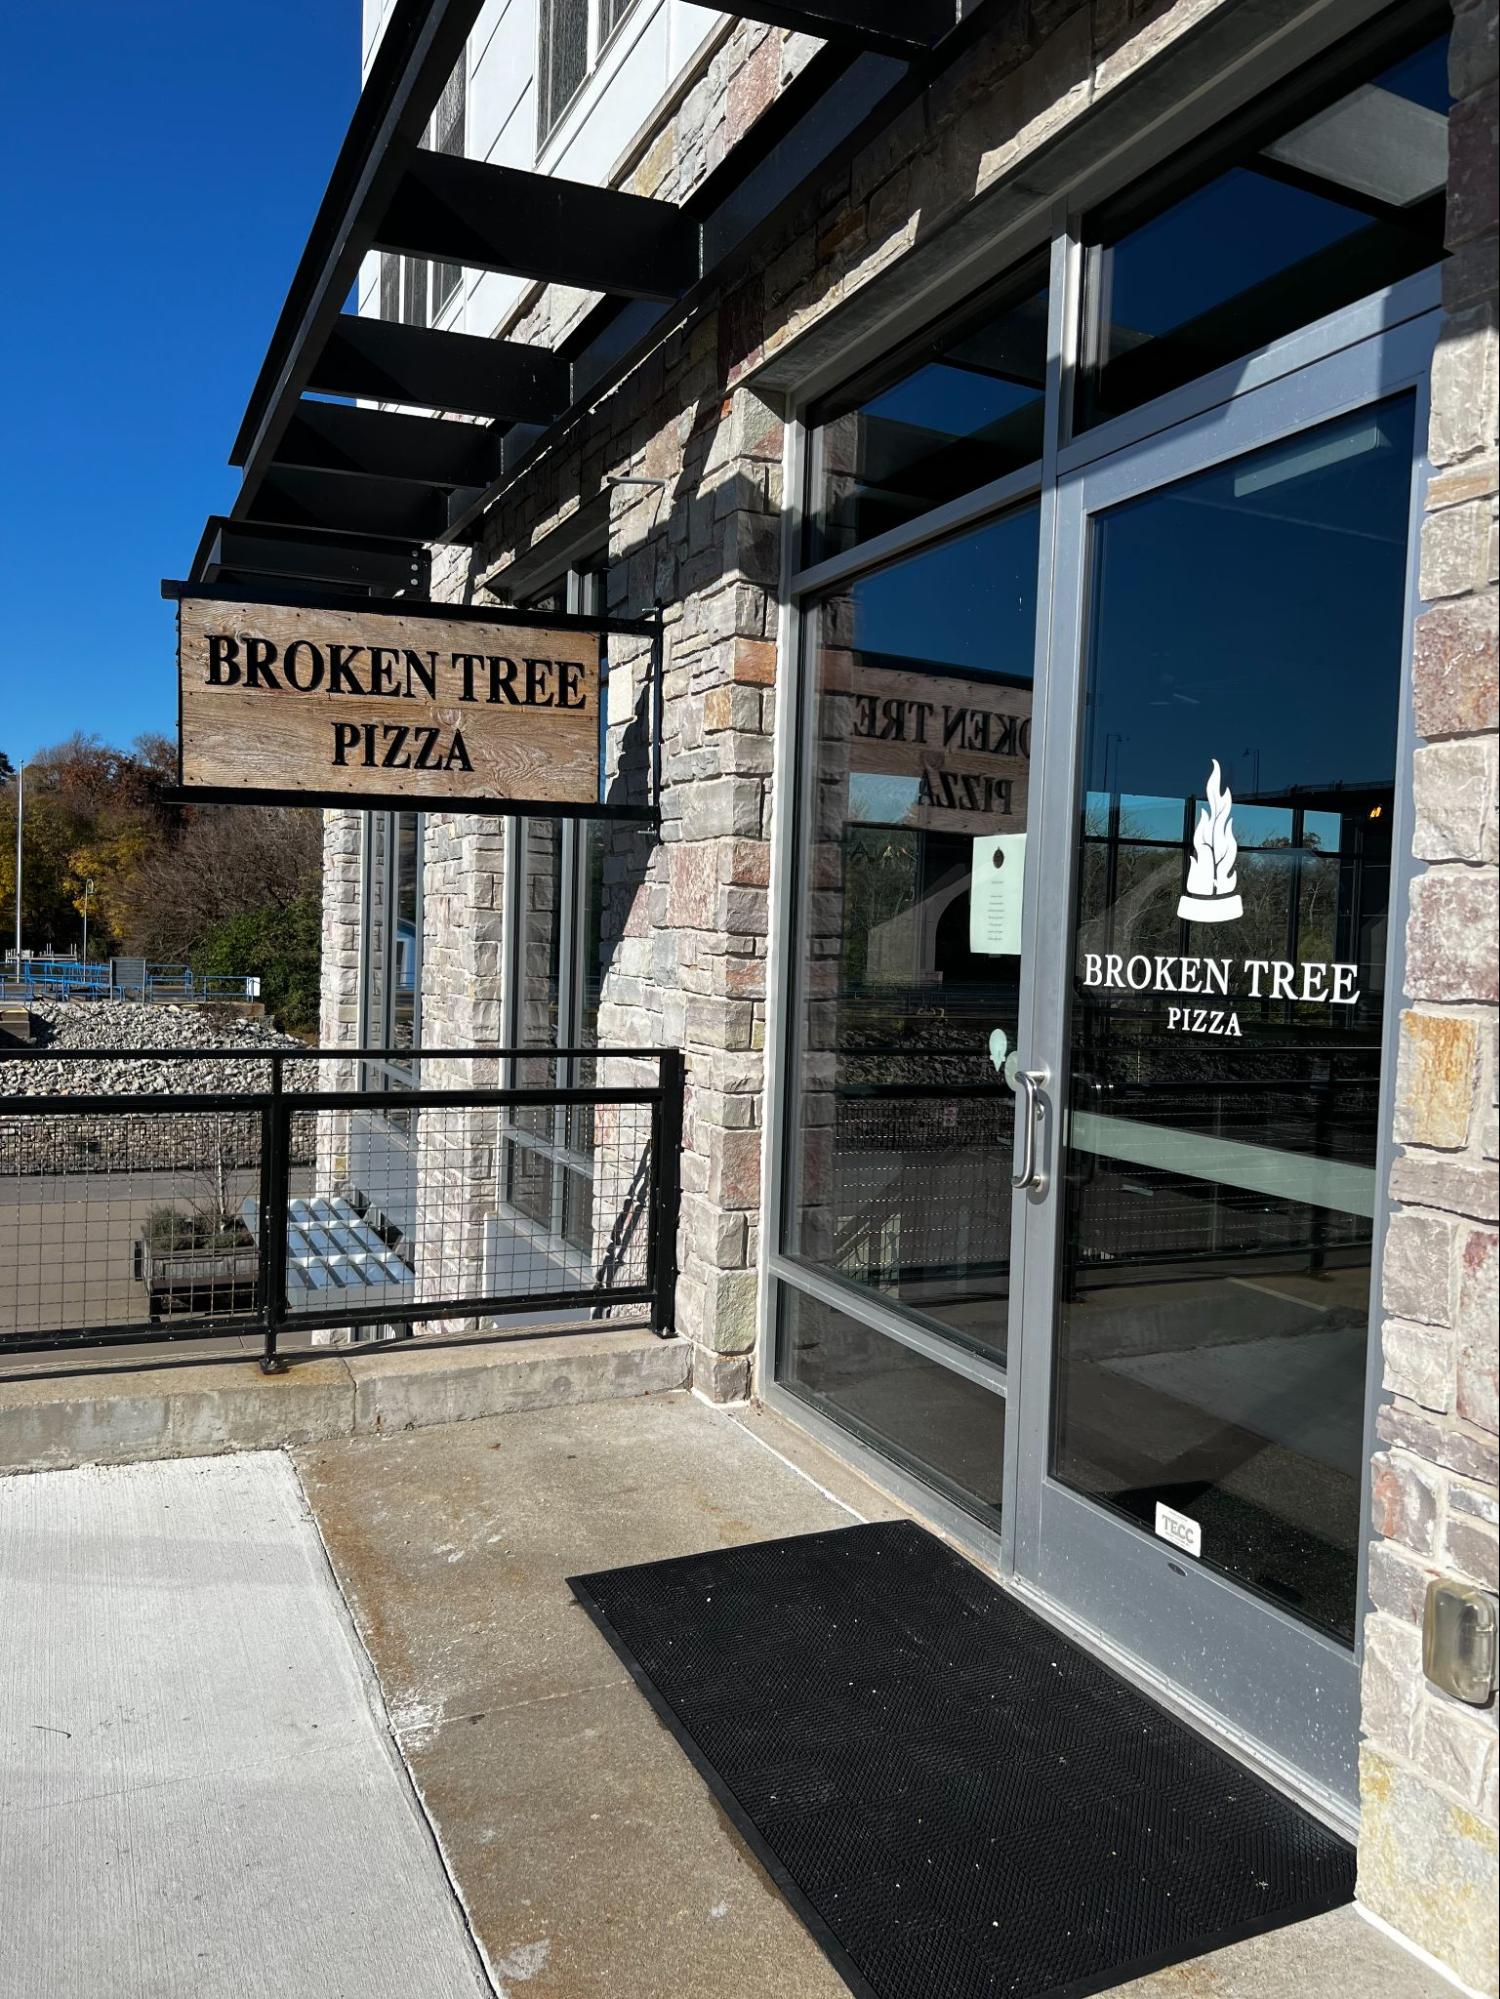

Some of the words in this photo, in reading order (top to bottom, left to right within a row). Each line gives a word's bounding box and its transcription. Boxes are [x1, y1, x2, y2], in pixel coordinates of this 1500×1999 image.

[205, 634, 438, 700] BROKEN
[452, 653, 586, 708] TREE
[331, 722, 475, 771] PIZZA
[1084, 953, 1232, 996] BROKEN
[1244, 960, 1361, 1004] TREE
[1167, 1007, 1242, 1036] PIZZA
[1162, 1514, 1194, 1544] TECC
